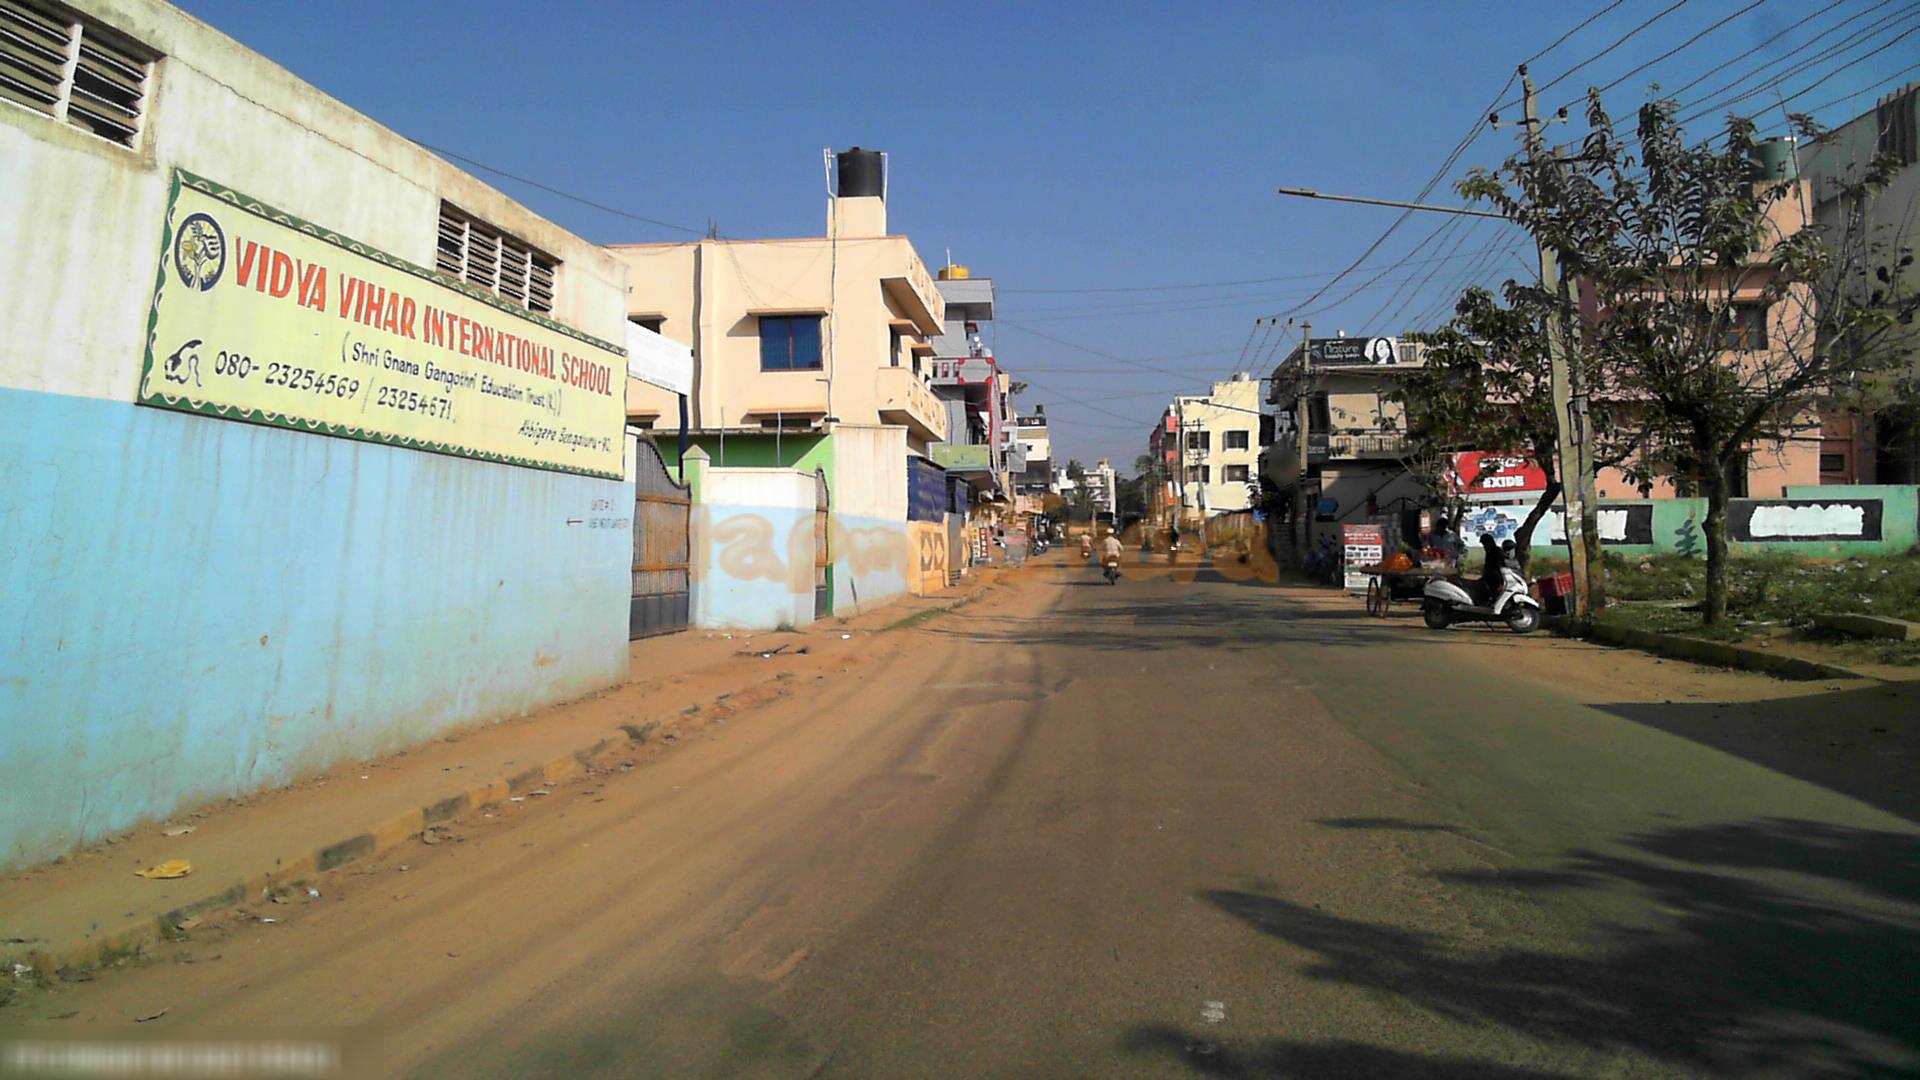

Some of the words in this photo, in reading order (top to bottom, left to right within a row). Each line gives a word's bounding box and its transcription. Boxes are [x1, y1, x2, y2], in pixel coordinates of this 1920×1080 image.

[235, 236, 327, 312] VIDYA
[340, 273, 416, 339] VIHAR
[423, 305, 556, 380] INTERNATIONAL
[561, 353, 612, 396] SCHOOL
[384, 350, 420, 376] Gnana
[481, 375, 523, 400] Education
[1482, 475, 1524, 488] EXIDE
